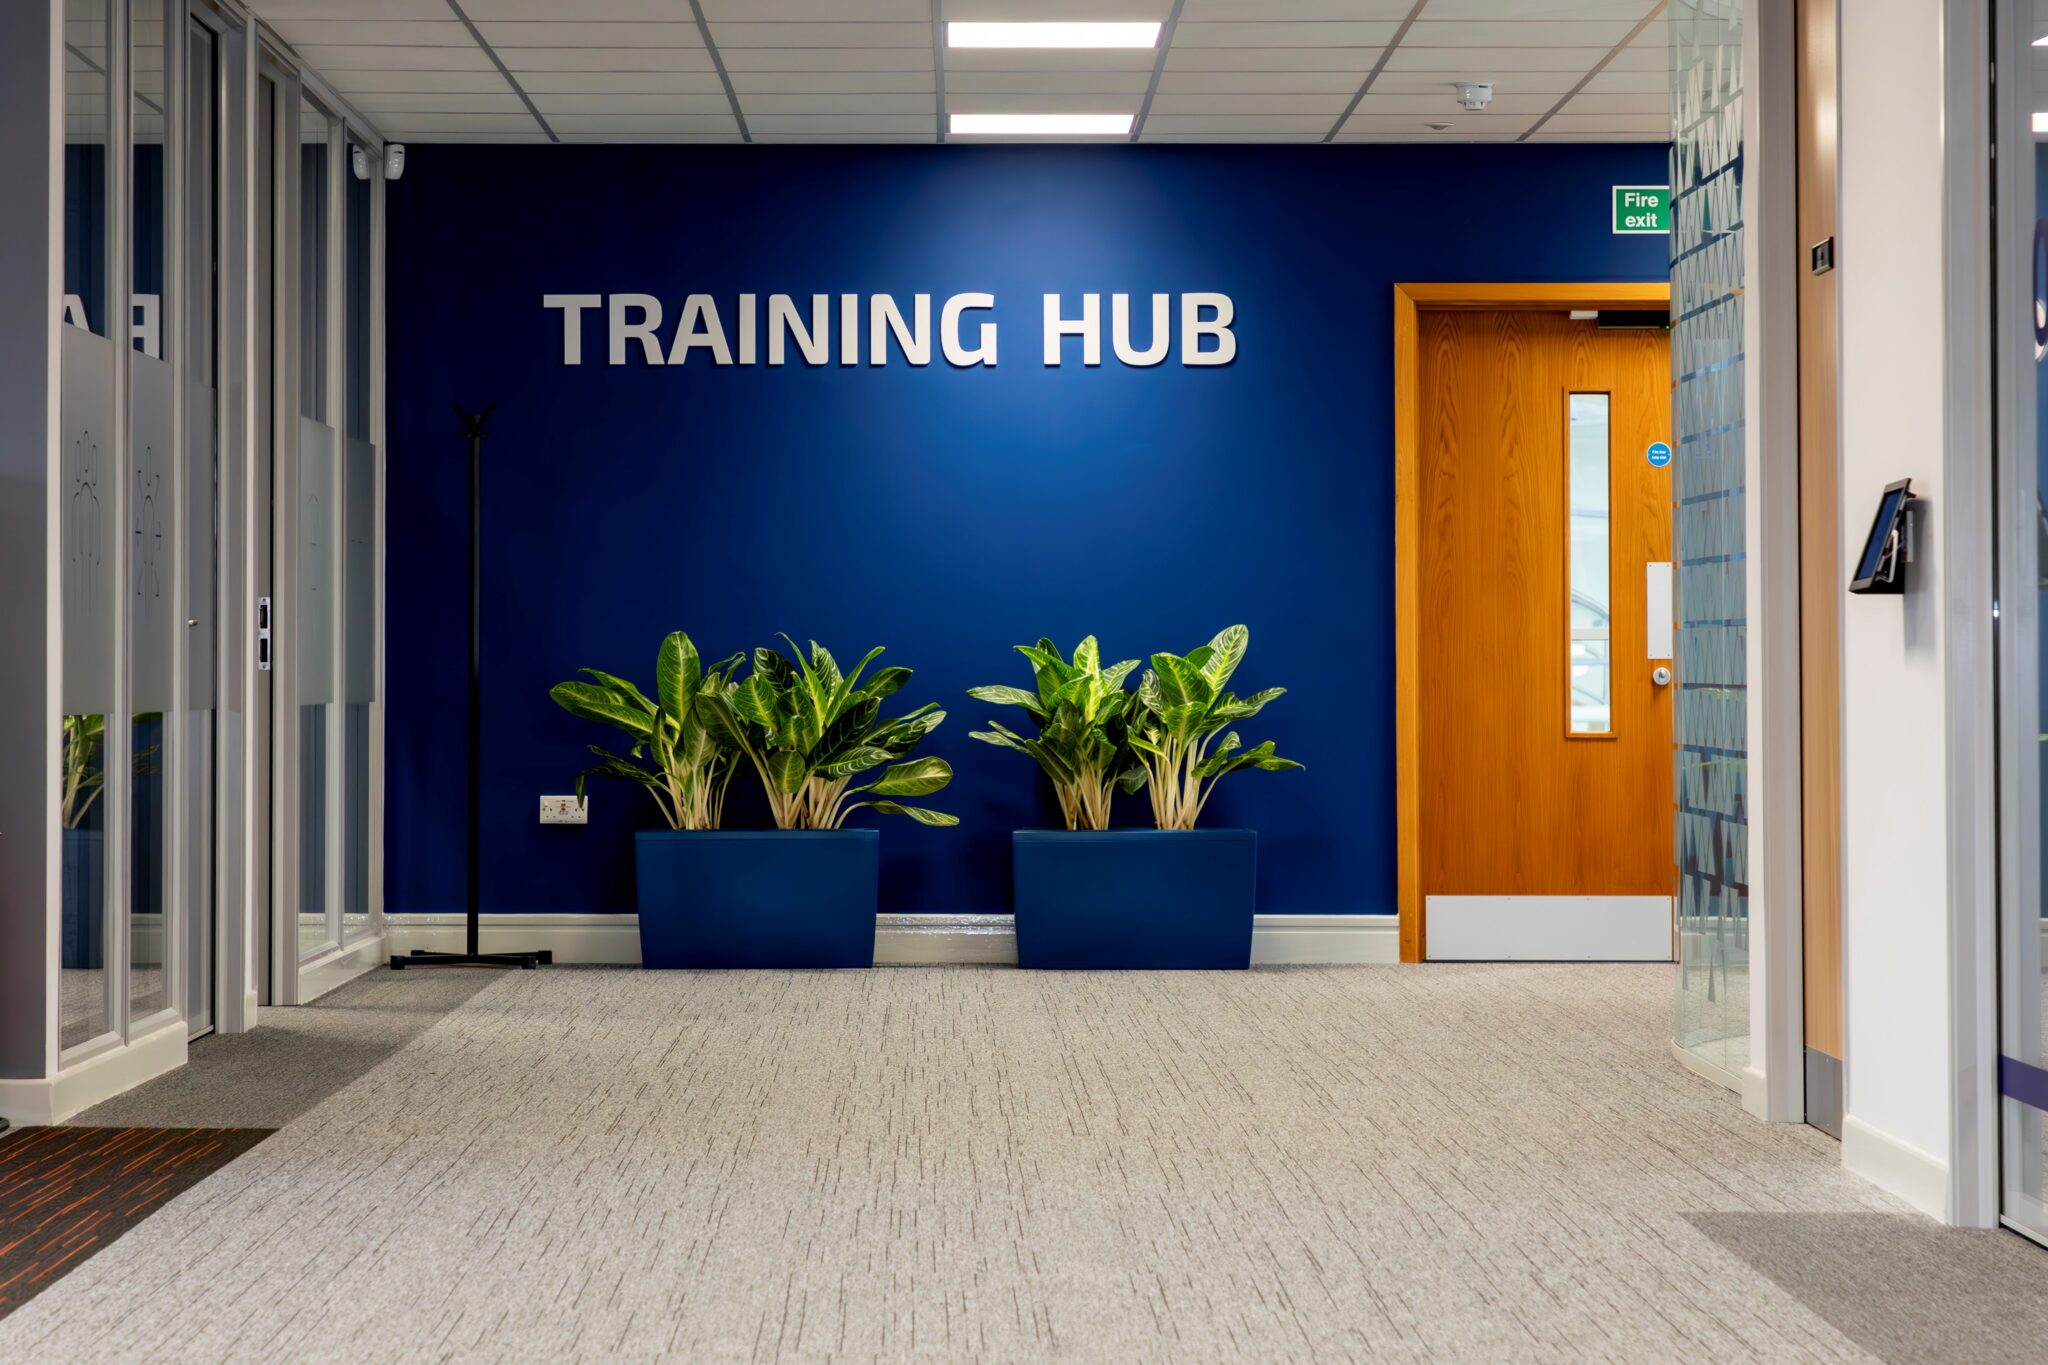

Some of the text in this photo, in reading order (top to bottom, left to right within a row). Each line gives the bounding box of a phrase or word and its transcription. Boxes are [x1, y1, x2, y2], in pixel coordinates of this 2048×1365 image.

[1624, 192, 1659, 208] Fire
[1624, 212, 1658, 228] exit
[543, 292, 1237, 367] TRAINING HUB
